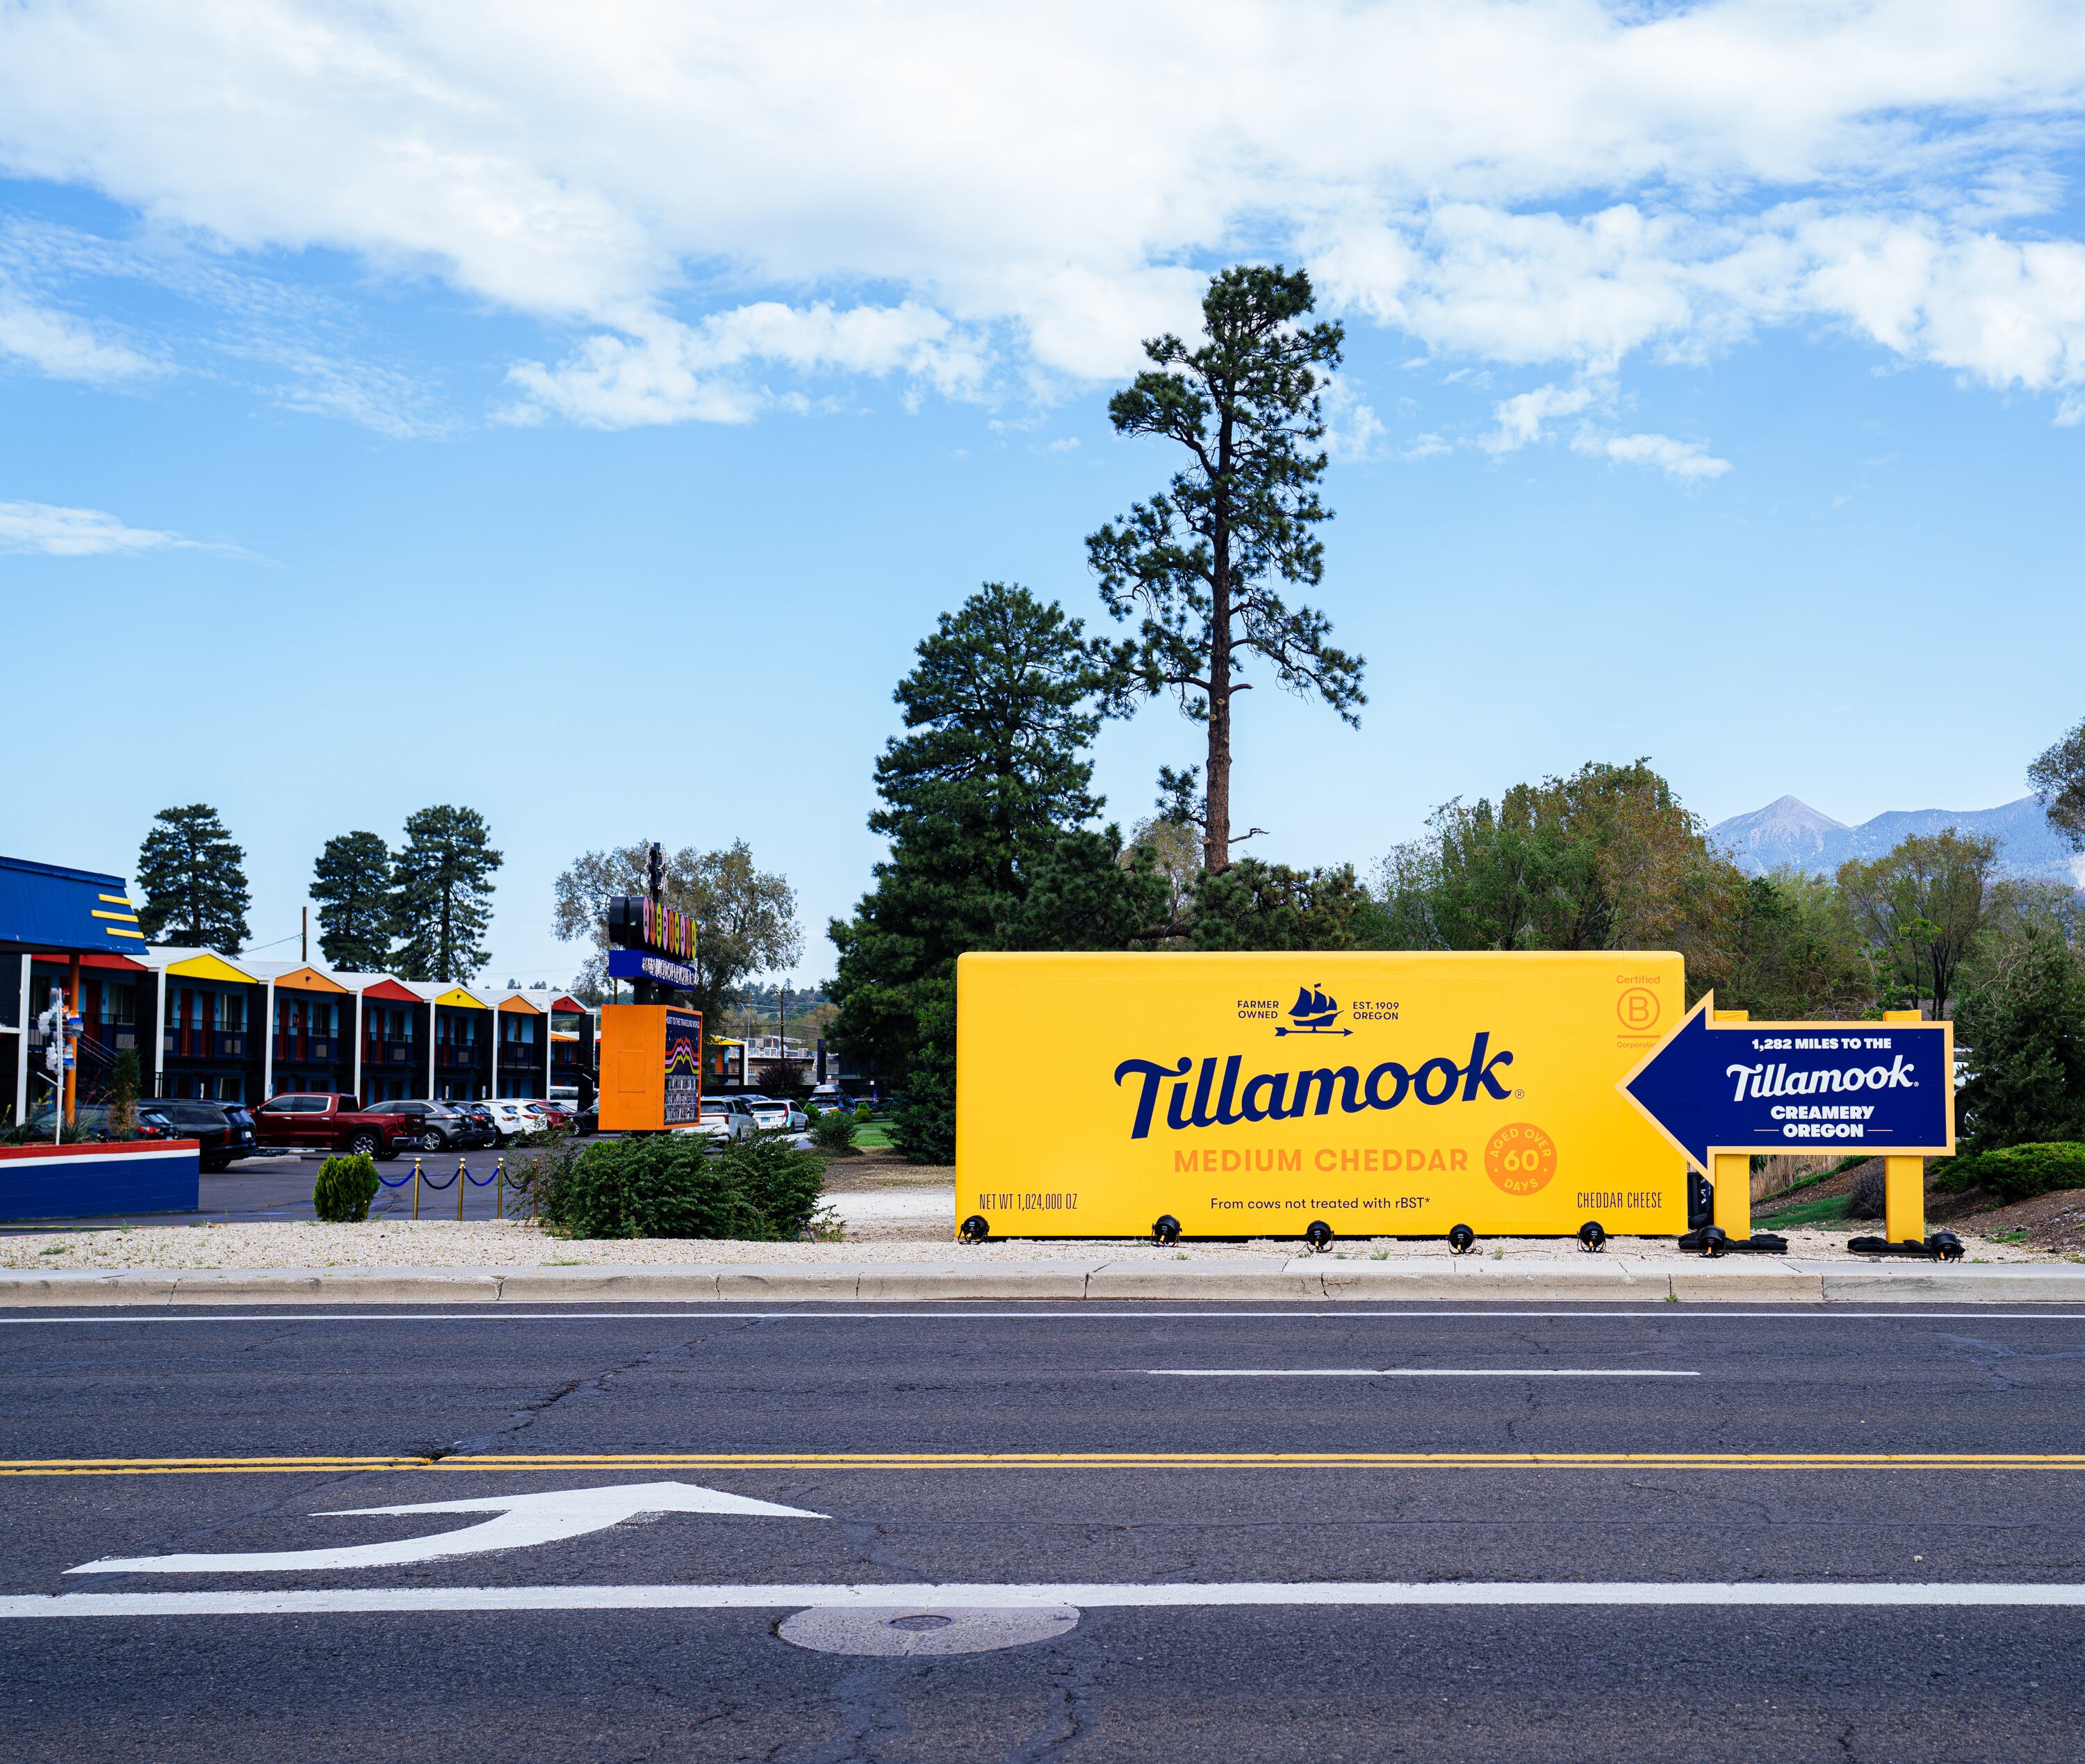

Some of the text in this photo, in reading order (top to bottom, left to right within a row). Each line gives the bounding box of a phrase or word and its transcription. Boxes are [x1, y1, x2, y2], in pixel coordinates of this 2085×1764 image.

[644, 907, 696, 950] AMERICANA
[1616, 975, 1660, 984] Certified
[1237, 1000, 1279, 1008] FARMER
[1352, 1002, 1399, 1010] EST. 1909
[1628, 996, 1649, 1022] B
[1238, 1011, 1278, 1019] OWNED
[1353, 1012, 1398, 1020] OREGON
[1617, 1041, 1656, 1050] Corporatio
[1751, 1038, 1892, 1052] 1,282 MILES TO THE
[1770, 1105, 1875, 1120] CREAMERY
[1783, 1123, 1864, 1138] OREGON
[1489, 1128, 1552, 1158] AGED OVER
[1175, 1148, 1468, 1173] MEDIUM CHEDDAR
[1503, 1149, 1539, 1172] 60
[1503, 1178, 1539, 1191] DAYS
[979, 1193, 1077, 1211] NET WT 1,024,000 OZ
[1211, 1198, 1243, 1209] From
[1248, 1201, 1281, 1209] cows
[1285, 1198, 1307, 1209] not
[1311, 1197, 1358, 1209] treated
[1363, 1197, 1391, 1209] with
[1577, 1192, 1662, 1208] CHEDDAR CHEESE
